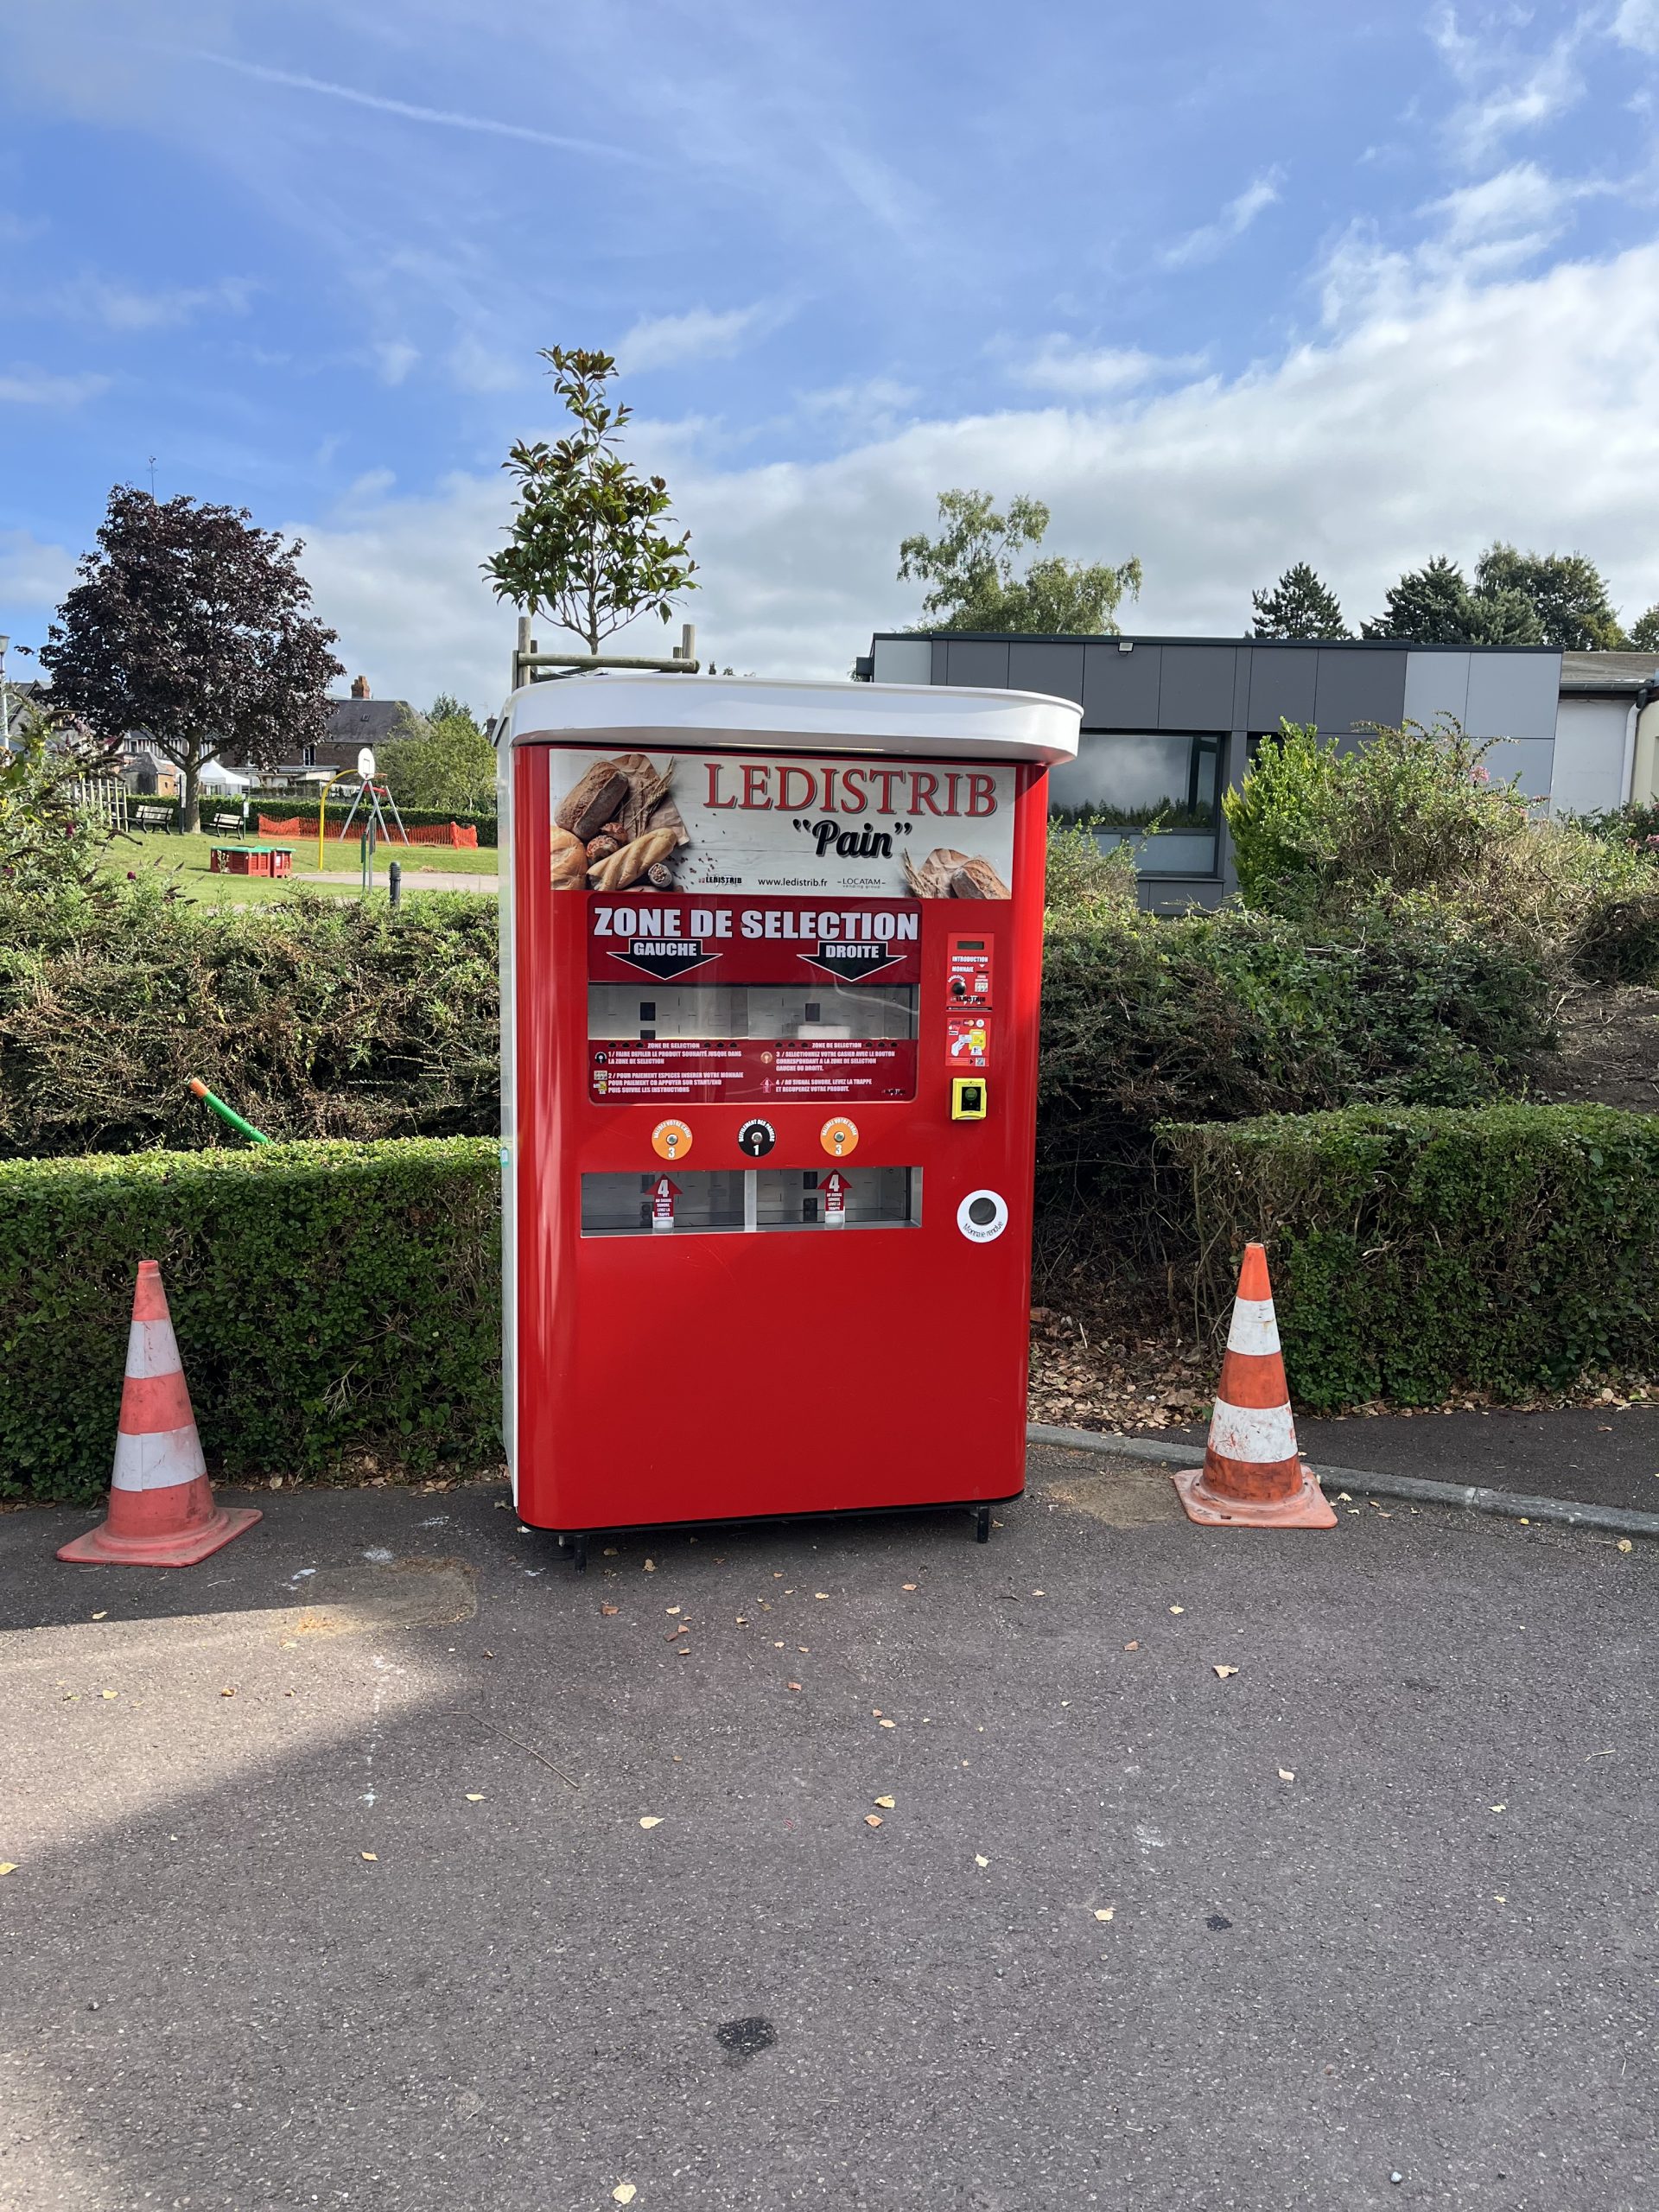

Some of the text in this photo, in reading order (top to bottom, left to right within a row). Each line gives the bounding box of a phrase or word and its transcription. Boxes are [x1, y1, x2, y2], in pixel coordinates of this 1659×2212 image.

[703, 763, 997, 817] LEDISTRIB
[758, 878, 828, 887] www.ledistrib.fr
[594, 907, 918, 940] ZONE DE SELECTION
[633, 943, 697, 957] GAUCHE
[825, 944, 880, 958] DROITE
[668, 1147, 676, 1158] 3
[753, 1145, 759, 1155] 1
[835, 1144, 842, 1155] 3
[658, 1179, 669, 1198] 4
[830, 1175, 840, 1192] 4
[963, 1224, 985, 1237] Monnaie
